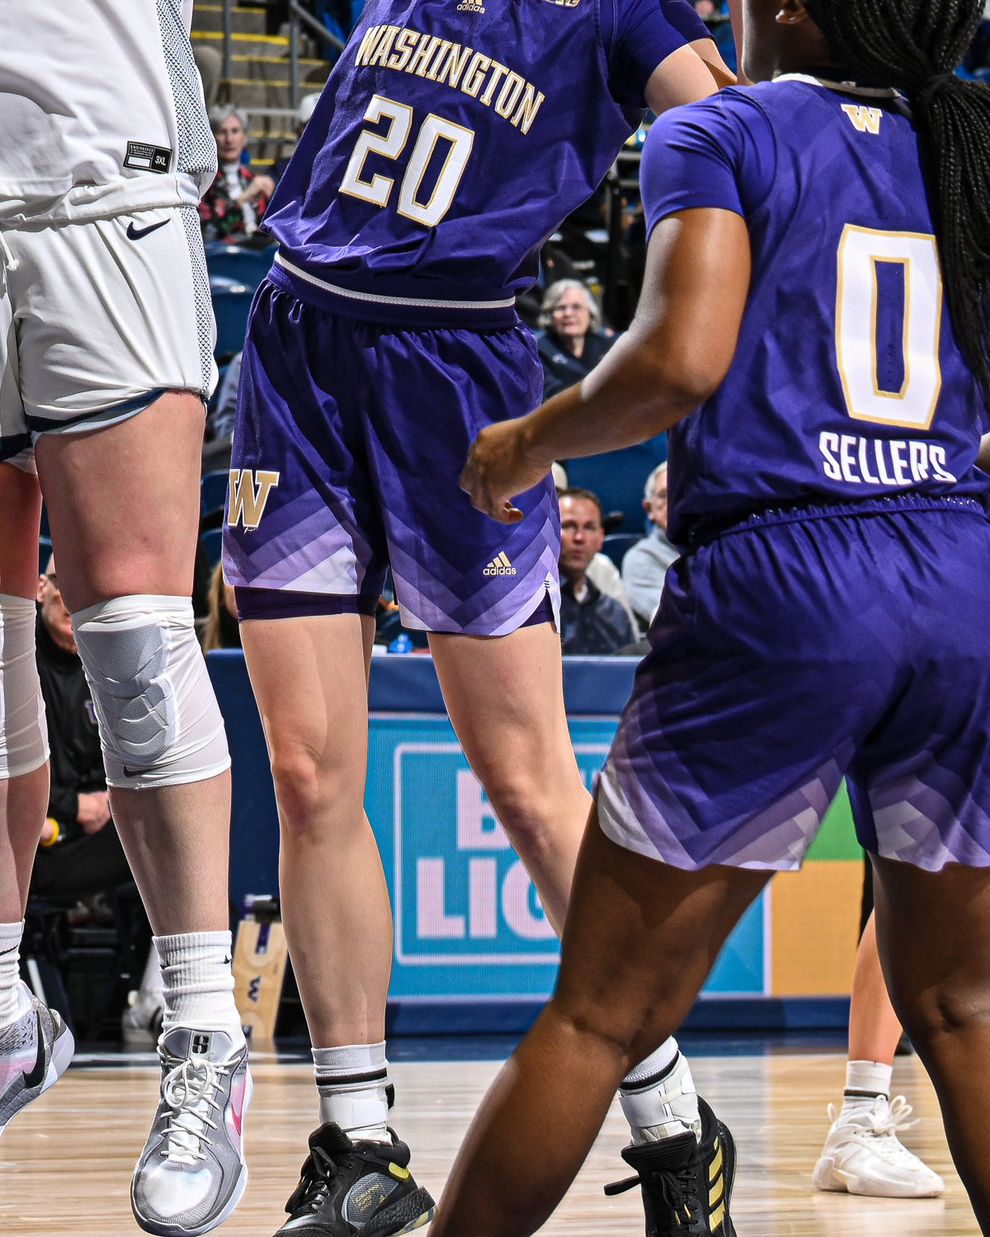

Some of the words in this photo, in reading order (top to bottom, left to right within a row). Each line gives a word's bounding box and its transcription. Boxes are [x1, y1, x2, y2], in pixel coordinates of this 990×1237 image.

[456, 3, 486, 15] adidas
[354, 24, 546, 136] WASHINGTON
[841, 103, 883, 135] W
[338, 93, 476, 228] 20
[835, 222, 943, 430] 0
[818, 430, 959, 486] SELLERS
[227, 468, 280, 528] W
[482, 566, 517, 576] adidas
[417, 858, 560, 940] LIG
